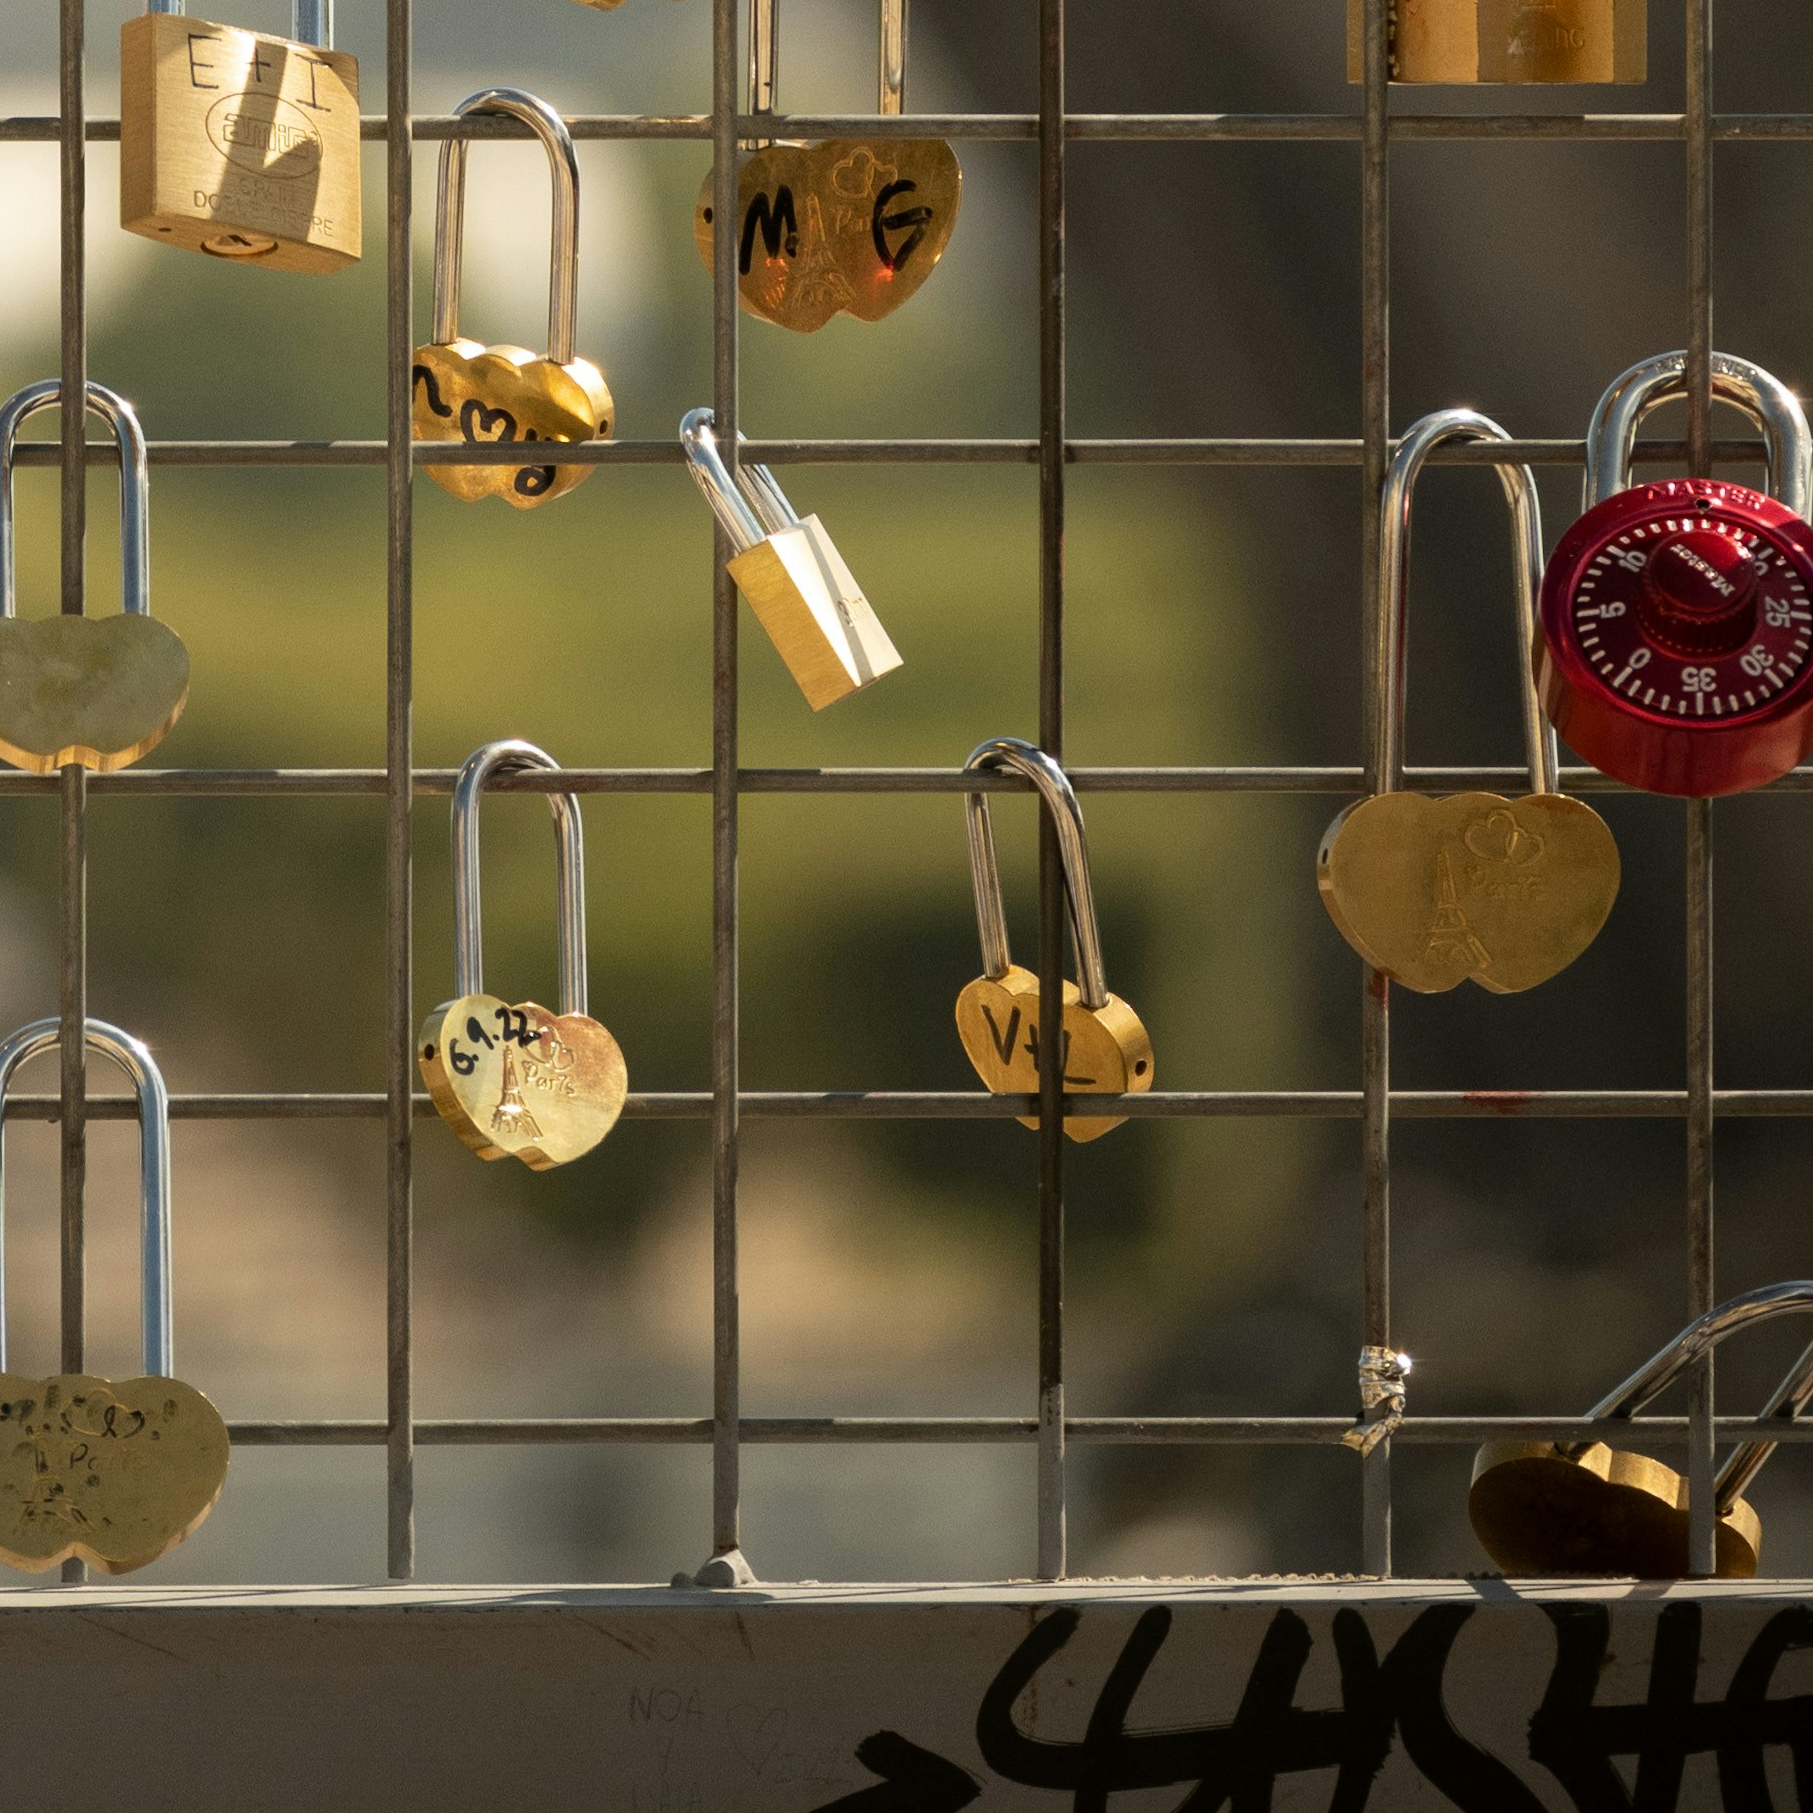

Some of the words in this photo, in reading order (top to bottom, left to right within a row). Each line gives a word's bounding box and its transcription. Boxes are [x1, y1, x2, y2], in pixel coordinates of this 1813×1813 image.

[187, 32, 222, 90] E
[1680, 666, 1718, 693] 35
[522, 1060, 576, 1097] Paris
